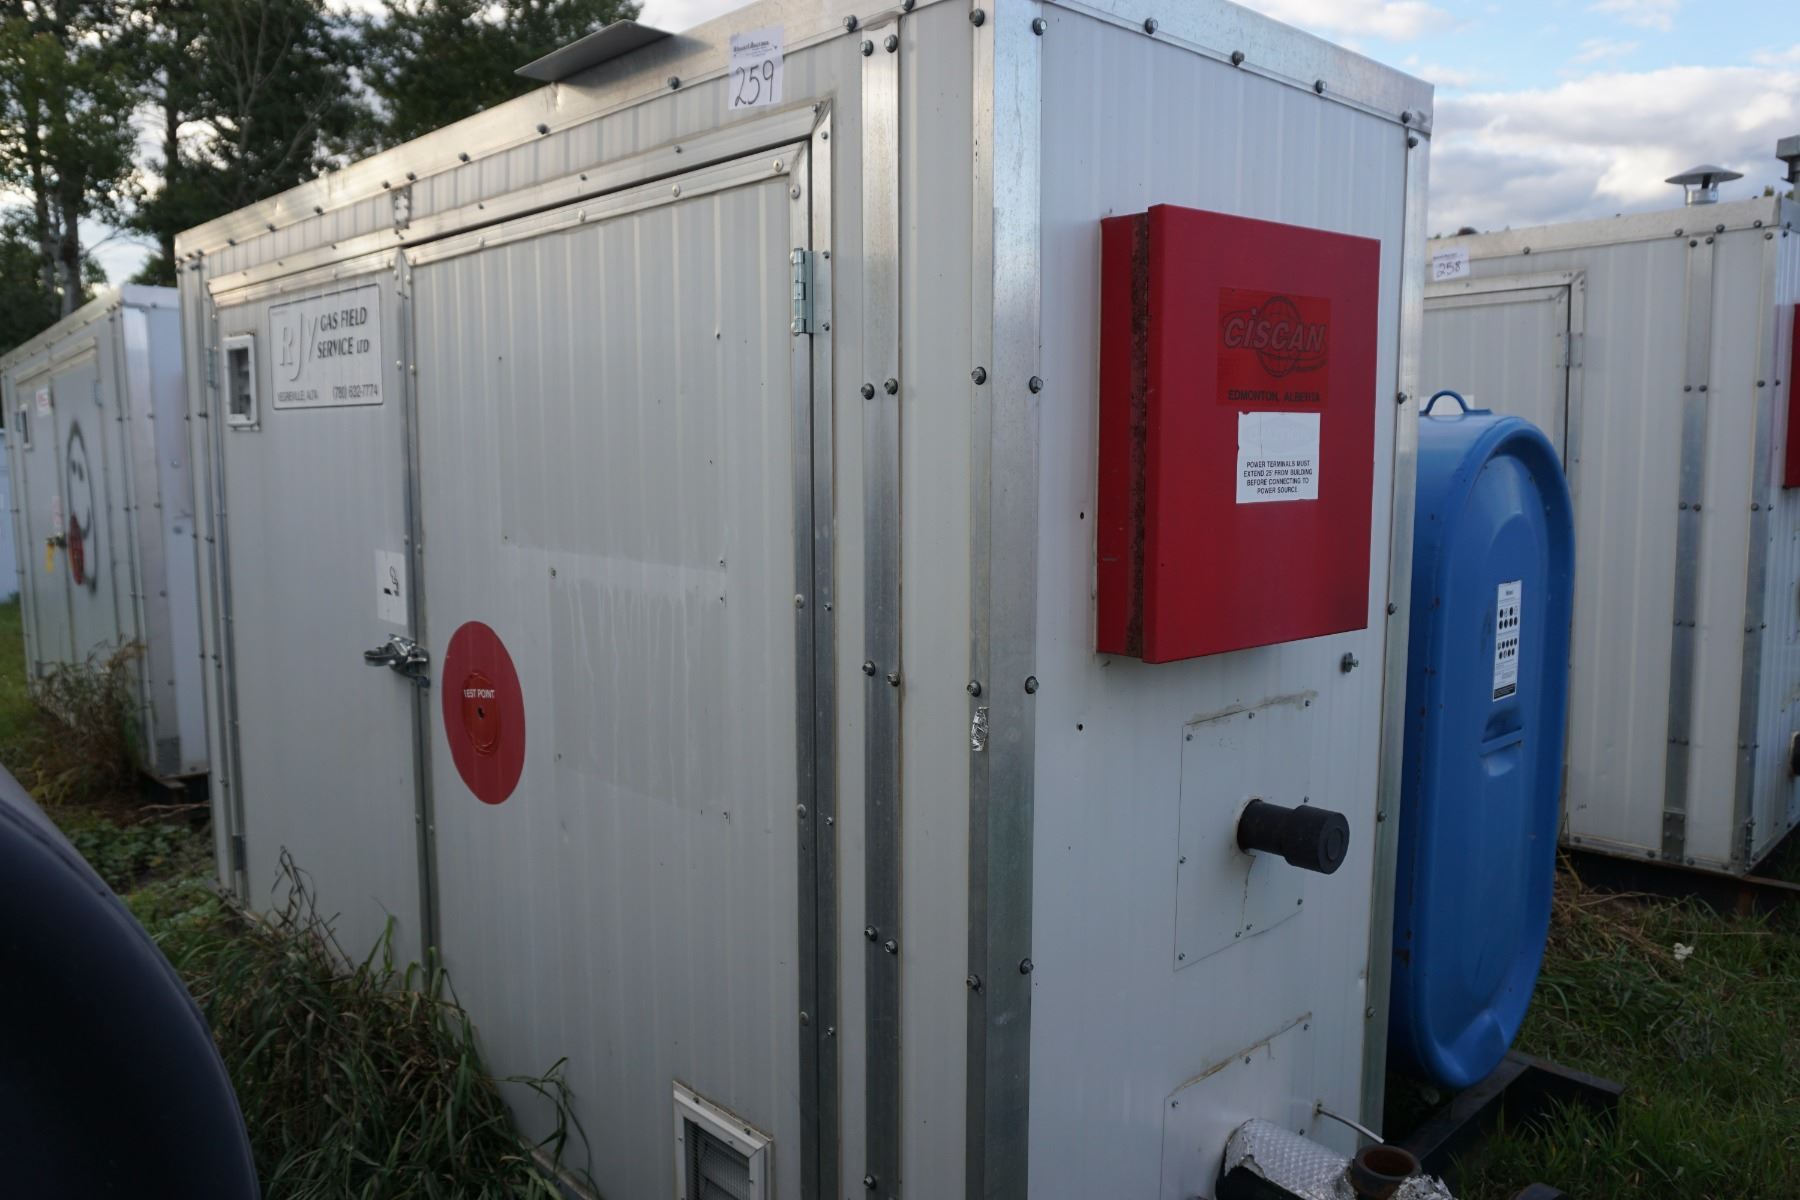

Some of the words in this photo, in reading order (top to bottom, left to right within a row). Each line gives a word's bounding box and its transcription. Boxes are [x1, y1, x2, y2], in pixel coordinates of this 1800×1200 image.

[734, 59, 774, 107] 259
[1436, 260, 1461, 278] 258
[320, 311, 338, 332] GAS
[340, 306, 368, 329] FIELD
[317, 336, 354, 360] SERVICE
[356, 338, 370, 355] LTD
[1284, 391, 1321, 402] ALBERTA
[1246, 460, 1266, 468] POWER
[1267, 460, 1296, 468] TERMINALS
[1296, 459, 1311, 467] MUST
[1243, 470, 1265, 478] EXTEND
[1290, 468, 1313, 476] BUILDING
[1246, 478, 1268, 486] BEFORE
[1268, 477, 1301, 485] CONNECTING
[1257, 487, 1276, 495] POWER
[1277, 486, 1298, 494] SOURCE
[477, 689, 495, 699] POINT
